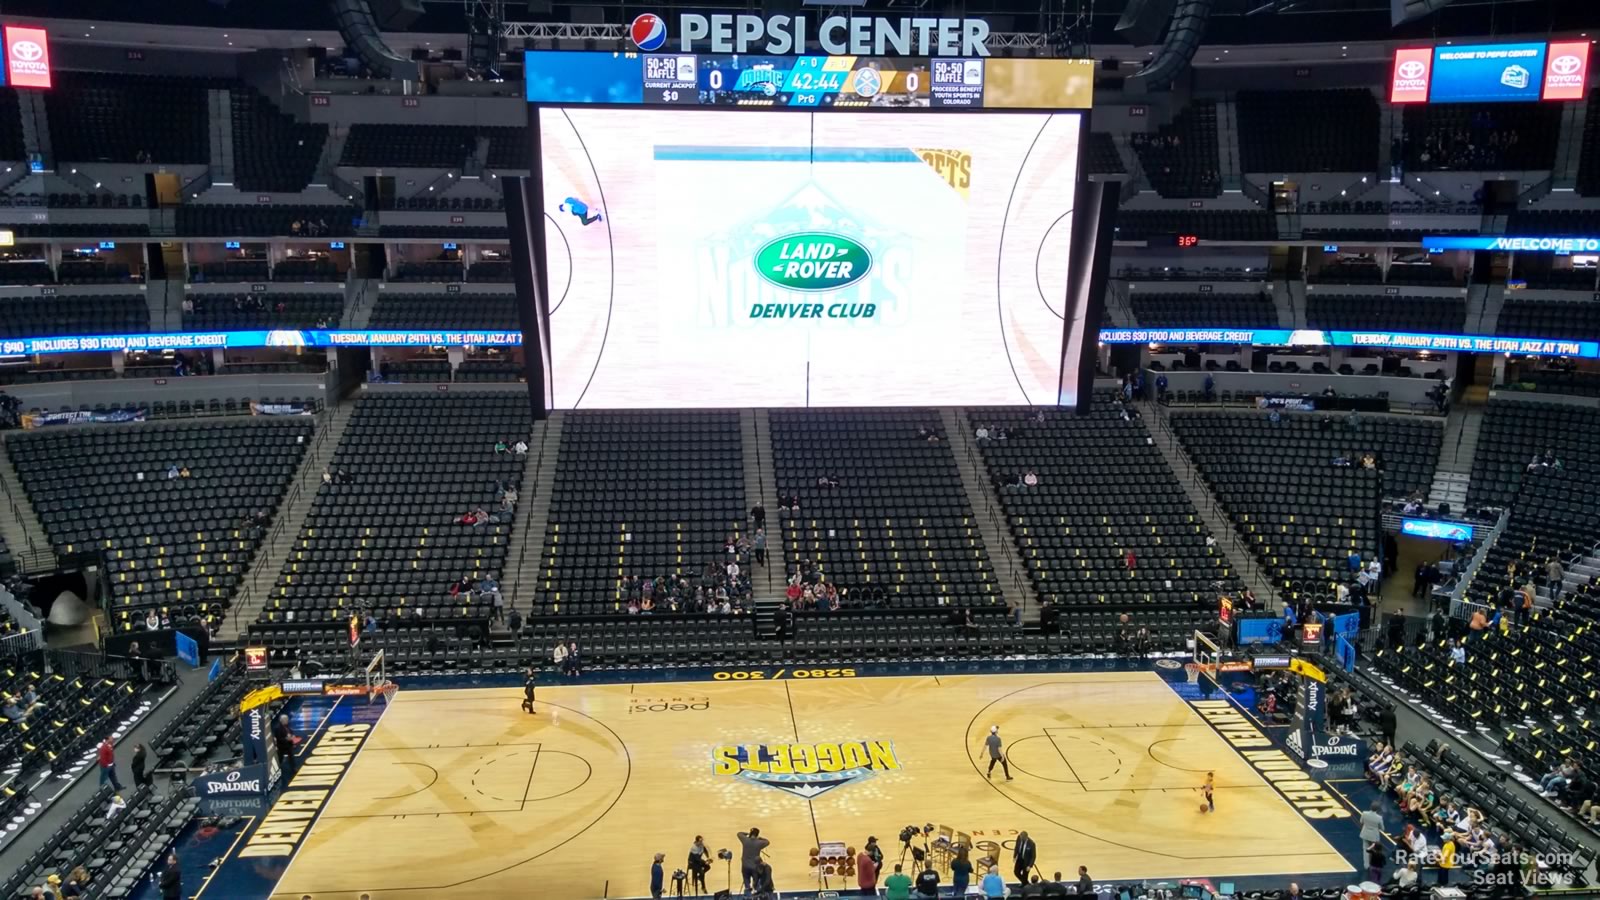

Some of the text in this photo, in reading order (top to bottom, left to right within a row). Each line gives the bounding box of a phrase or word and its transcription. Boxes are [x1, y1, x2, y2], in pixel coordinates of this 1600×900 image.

[680, 13, 991, 57] PEPSI CENTER
[1439, 49, 1538, 60] WELCOME TO PEPSI CENTER
[12, 61, 47, 70] TOYOTA
[647, 69, 675, 79] RAFFLE
[710, 70, 722, 89] 0
[791, 73, 840, 90] 42:44
[935, 73, 962, 83] RAFFLE
[1547, 75, 1582, 83] TOYOTA
[906, 72, 919, 92] 0
[1394, 79, 1426, 87] TOYOTA
[662, 91, 679, 102] $0
[779, 242, 837, 260] LAND
[1497, 238, 1598, 250] WELCOME TO
[784, 261, 853, 279] ROVER
[749, 303, 877, 319] DENVER CLUB
[32, 339, 79, 352] INCLUDES
[80, 338, 99, 350] $30
[101, 337, 127, 349] FOOD
[127, 337, 147, 348] AND
[147, 335, 194, 348] BEVERAGE
[194, 334, 228, 346] CREDIT
[329, 333, 369, 345] TUESDAY,
[370, 333, 407, 344] JANUARY
[408, 334, 431, 344] 24TH
[431, 333, 445, 344] VS.
[445, 333, 463, 344] THE
[463, 333, 485, 344] UTAH
[486, 333, 506, 344] JAZZ
[506, 333, 516, 343] AT
[1099, 331, 1254, 342] NCLUDES $30 FOOD AND BEVERAGE CREDIT
[1352, 334, 1579, 355] TUESDAY, JANUARY 24TH VS. THE UTAH JAZZ AT 7PM
[45, 411, 77, 421] PROTECT
[713, 670, 765, 681] 300
[793, 668, 856, 679] 5280
[1308, 681, 1319, 711] xfinity
[628, 700, 710, 715] pepsi
[250, 708, 262, 740] xfinity
[1189, 699, 1273, 748] DENVER
[289, 723, 371, 787] NUGGETS
[1312, 743, 1357, 757] SPALDING
[712, 740, 903, 776] NUGGETS
[207, 779, 260, 794] SPALDING
[1240, 749, 1352, 819] NUGGETS
[237, 789, 330, 858] DENVER
